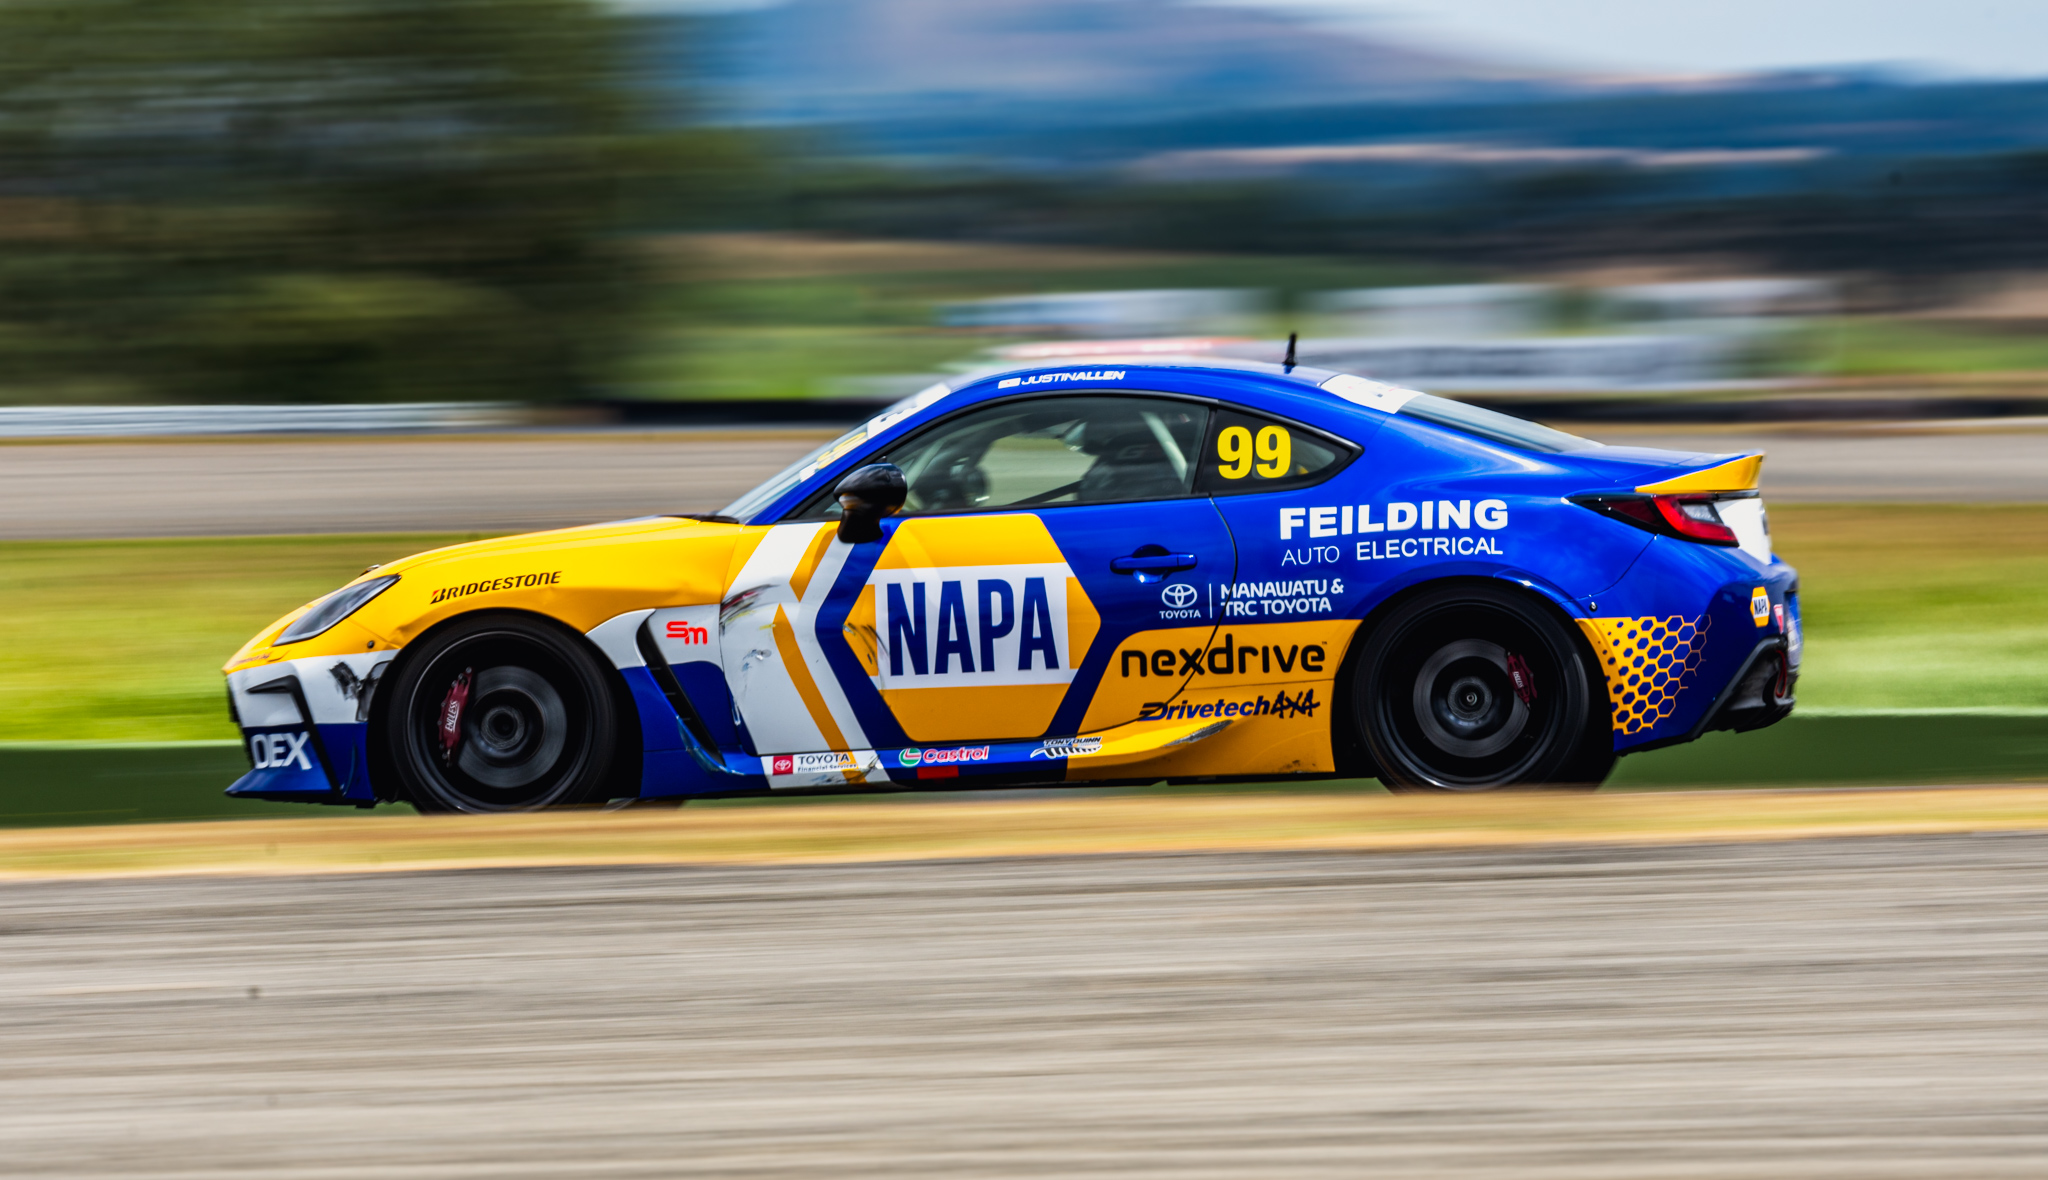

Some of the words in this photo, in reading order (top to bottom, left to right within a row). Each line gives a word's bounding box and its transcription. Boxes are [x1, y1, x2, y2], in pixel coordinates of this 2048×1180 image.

[1217, 425, 1292, 479] 99
[1280, 499, 1508, 540] FEILDING
[1281, 546, 1340, 567] AUTO
[1356, 537, 1503, 561] ELECTRICAL
[430, 571, 562, 605] BRIDGESTONE
[1220, 580, 1327, 599] MANAWATU
[1331, 578, 1344, 594] &
[1159, 609, 1201, 619] TOYOTA
[1260, 597, 1332, 615] TOYOTA
[1753, 597, 1768, 616] NAPA
[887, 576, 1060, 676] NAPA
[1121, 633, 1325, 678] nexdrive
[250, 731, 313, 770] OEX
[798, 753, 850, 765] TOYOTA
[922, 746, 989, 763] Castrol
[797, 765, 828, 773] Financial
